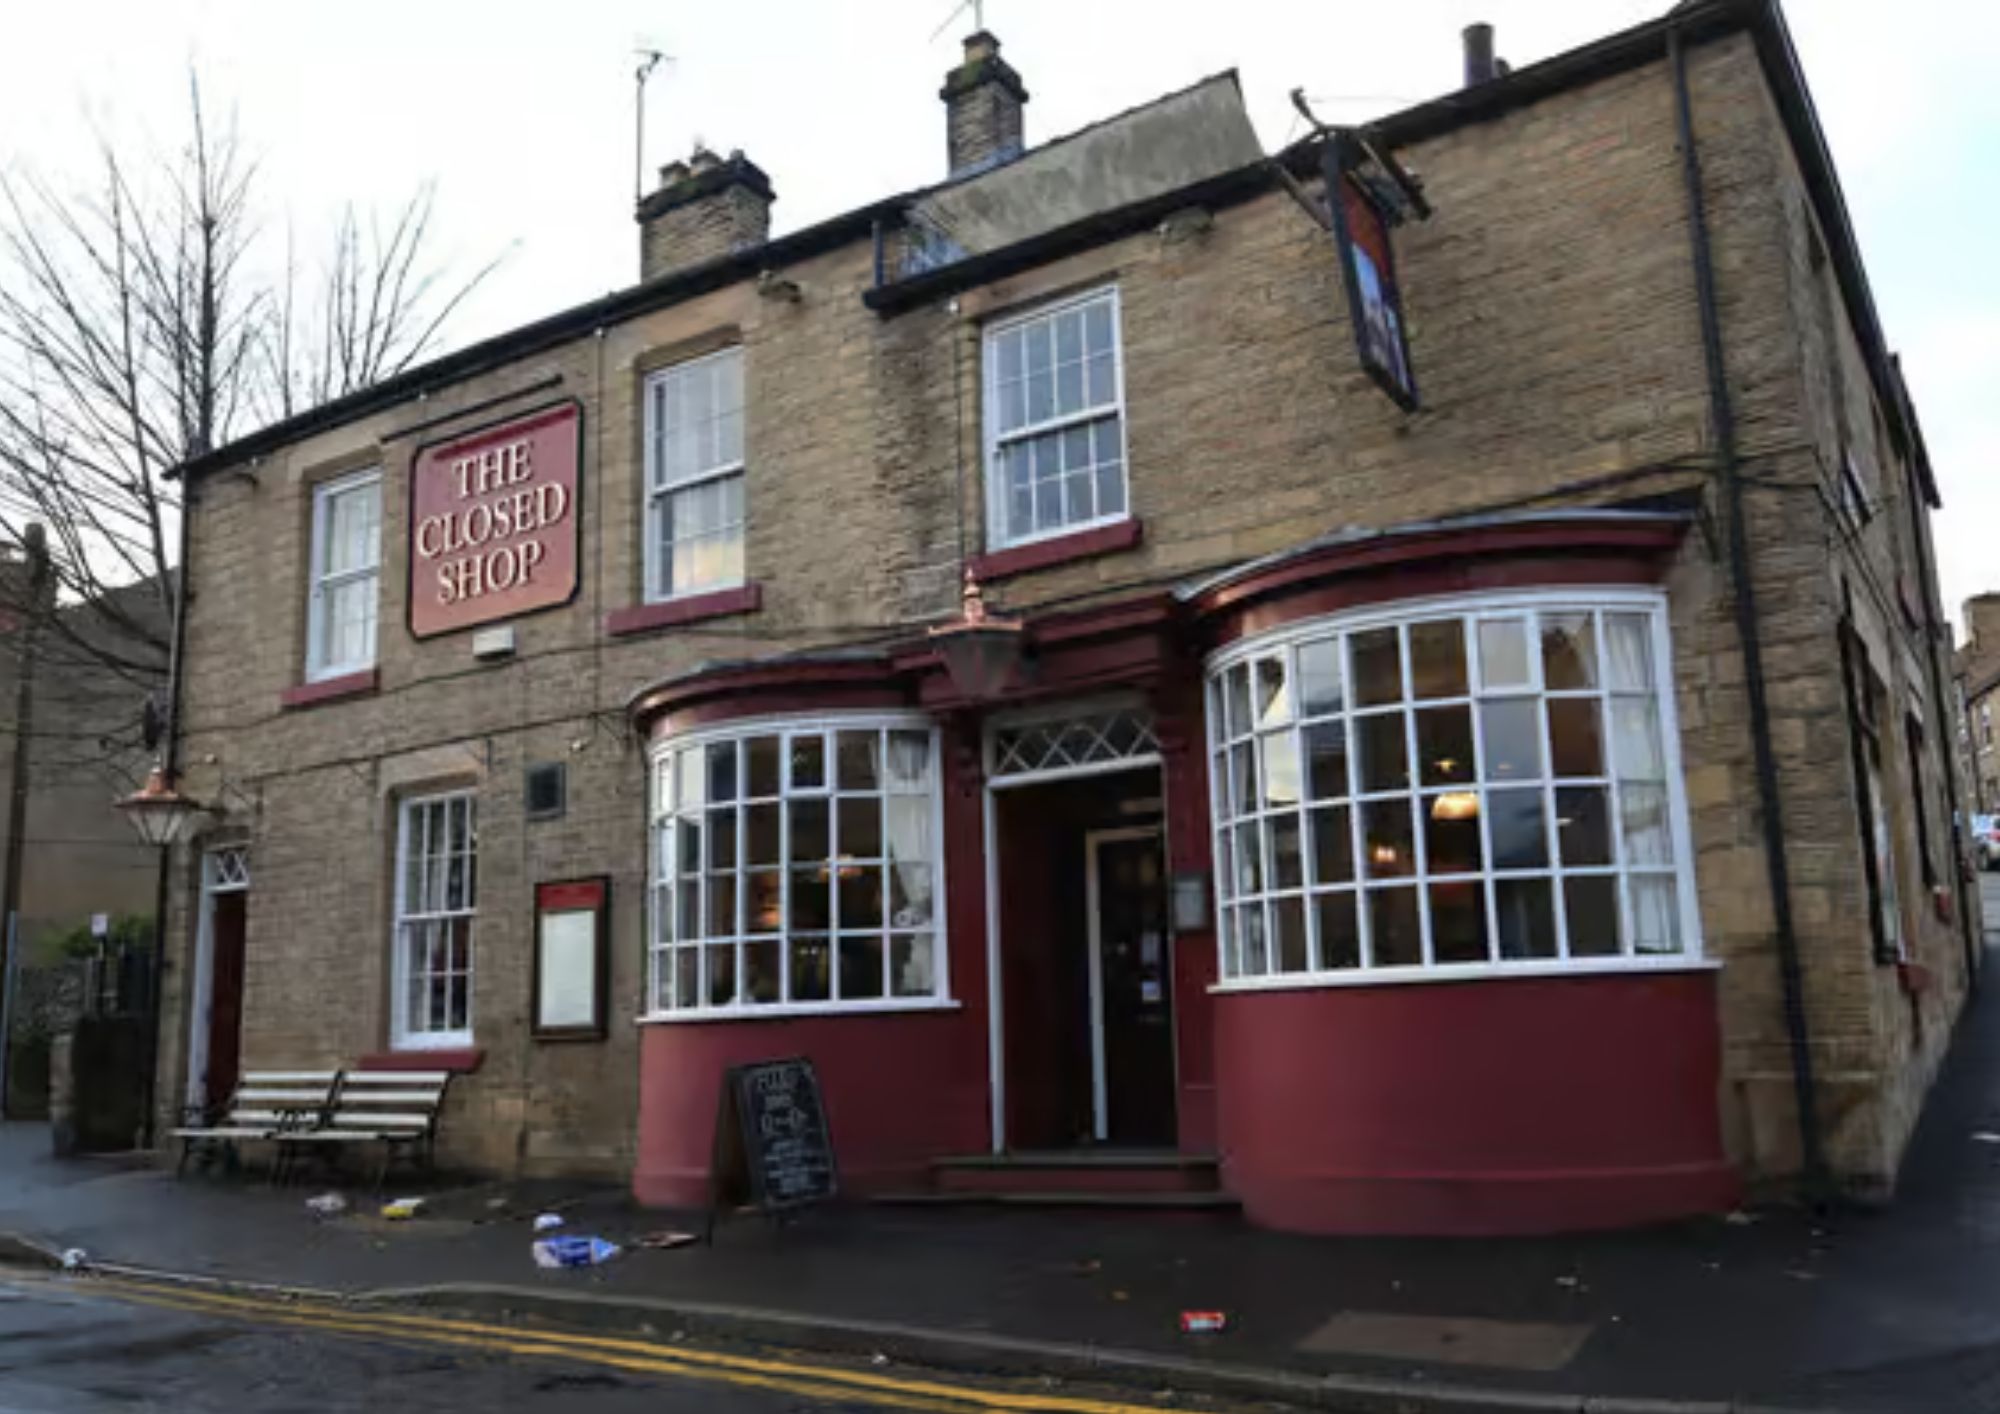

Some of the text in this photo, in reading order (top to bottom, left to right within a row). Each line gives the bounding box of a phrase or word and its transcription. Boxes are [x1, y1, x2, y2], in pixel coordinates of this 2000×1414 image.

[452, 439, 534, 498] THE
[417, 480, 569, 558] CLOSED
[437, 540, 546, 604] SHOP
